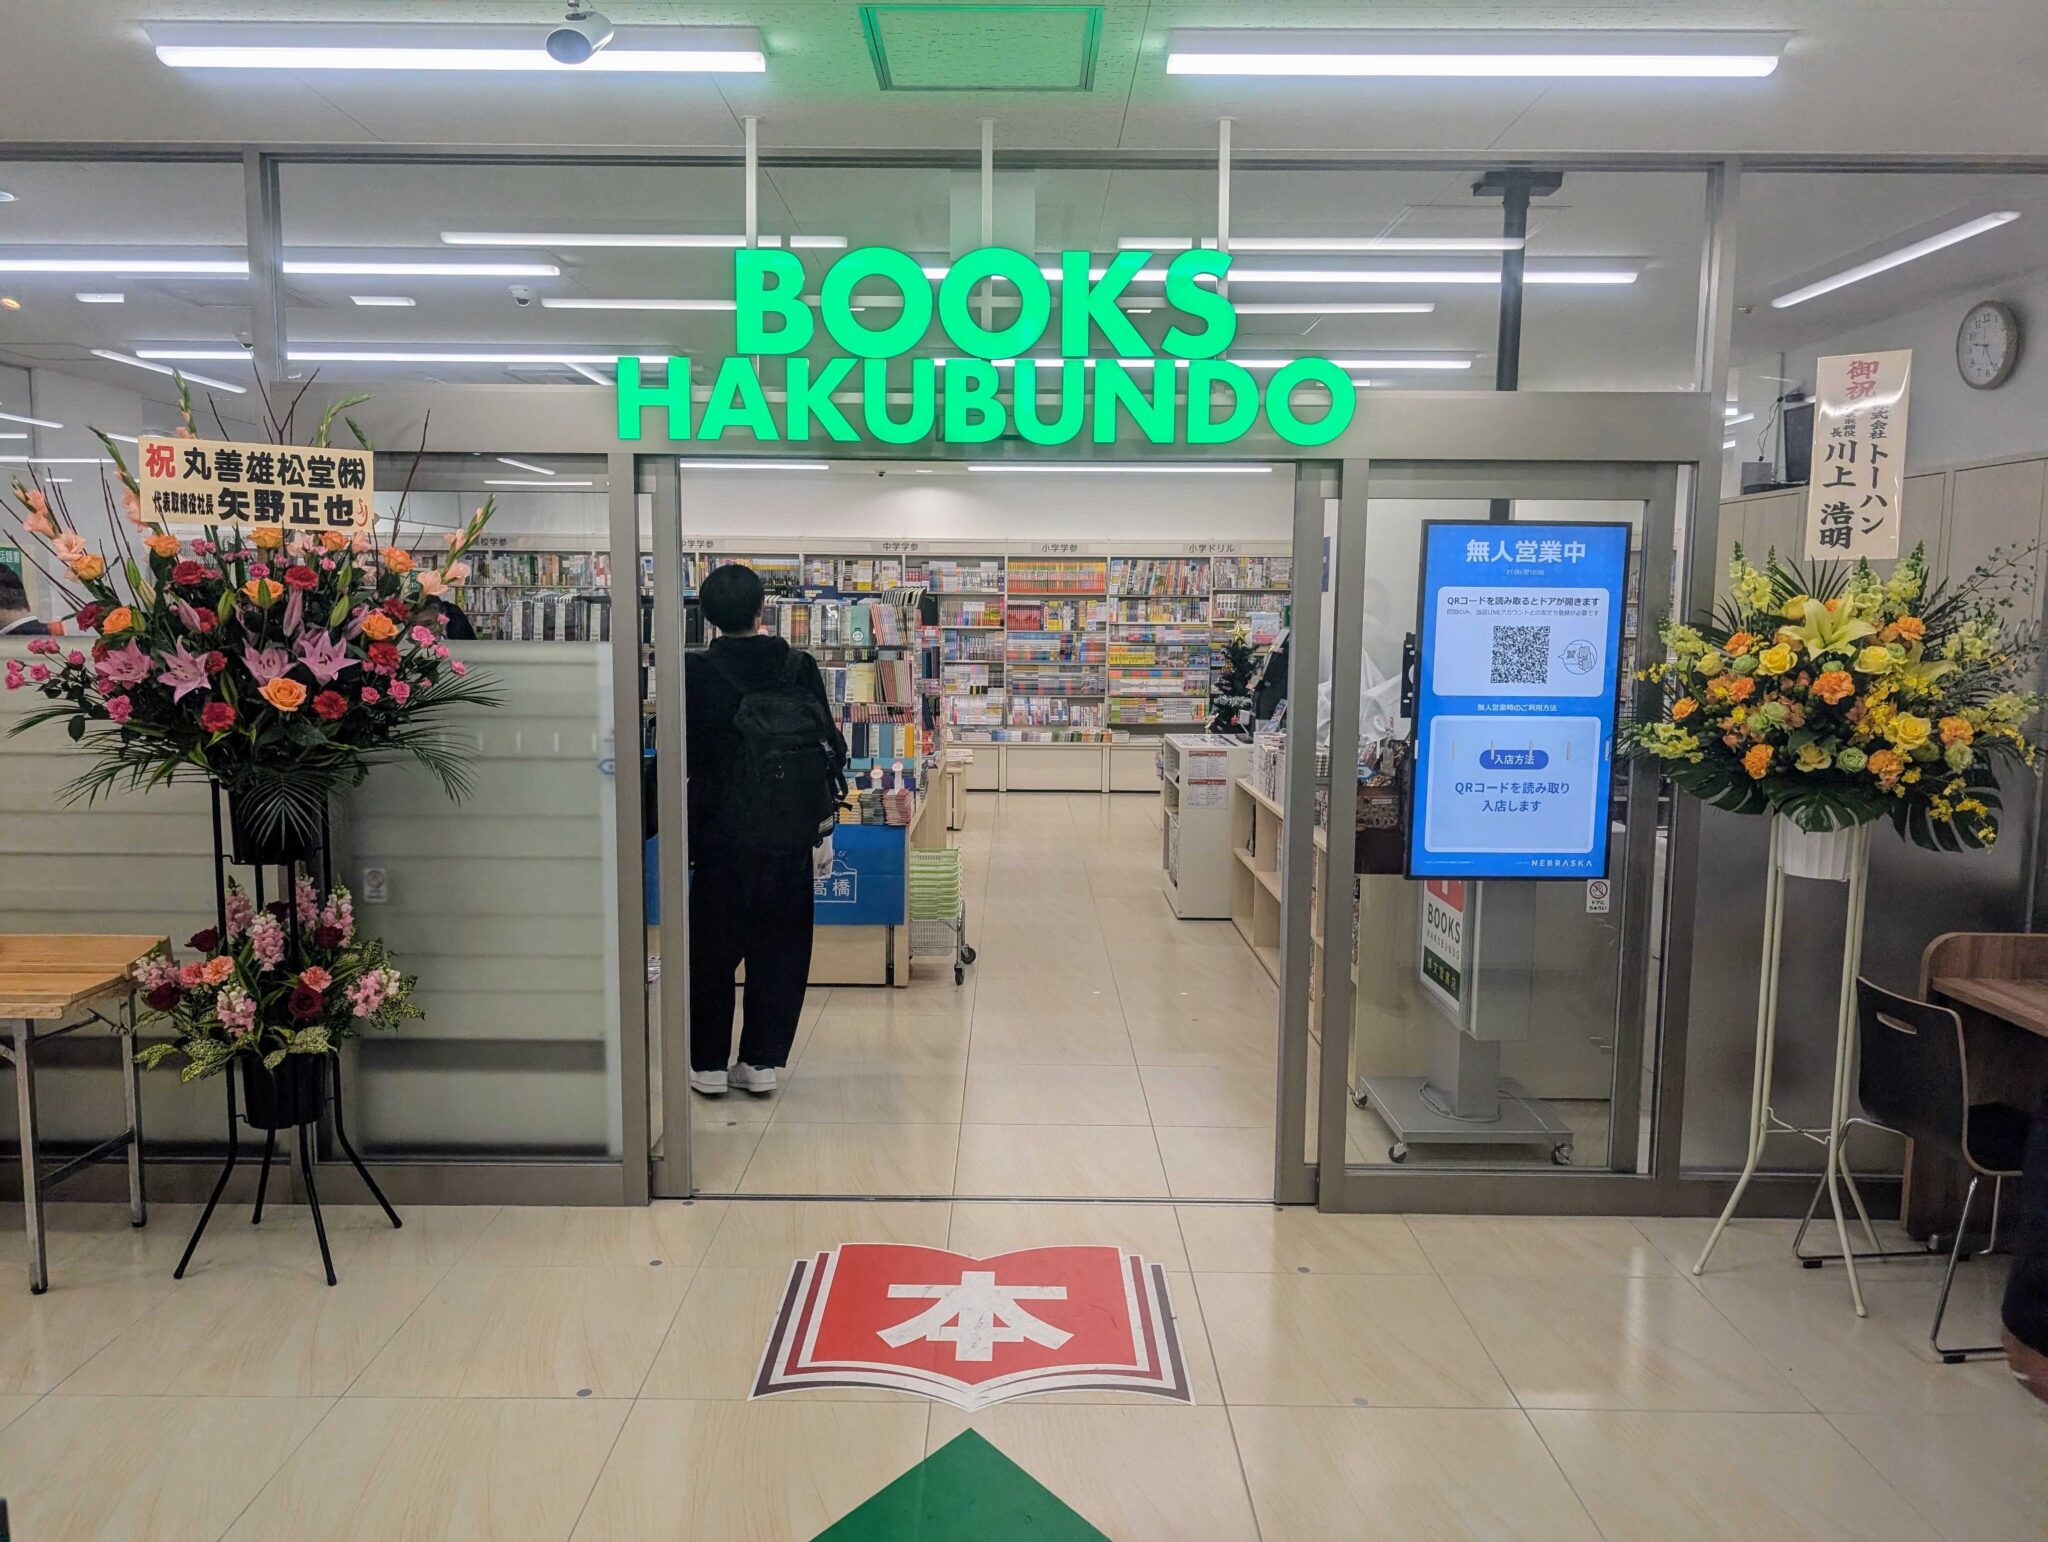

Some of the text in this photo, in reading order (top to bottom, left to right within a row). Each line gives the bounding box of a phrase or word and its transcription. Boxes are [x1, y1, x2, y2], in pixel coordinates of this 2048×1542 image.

[735, 247, 1238, 359] BOOKS
[1845, 360, 1879, 398] 御祝
[617, 356, 1357, 446] HAKUBUNDO
[145, 443, 176, 478] 祝
[152, 490, 214, 516] 代表取締役社長
[218, 487, 354, 526] 矢野正也
[882, 542, 919, 551] 中学学参
[1042, 543, 1078, 552] 小学学参
[1188, 543, 1236, 553] 小学ドリル
[1466, 539, 1586, 563] 無人営業中
[1447, 596, 1600, 607] QRコードを読み取るとドアが開きます
[1477, 703, 1557, 711] 無人営業時のご利用方法
[1494, 754, 1535, 765] 入店方法
[1455, 782, 1570, 795] QRコードを読み取り
[1482, 800, 1542, 813] 入店します
[1531, 859, 1593, 867] NEBRASKA
[1427, 902, 1460, 944] BOOKS
[875, 1270, 1075, 1362] 本
